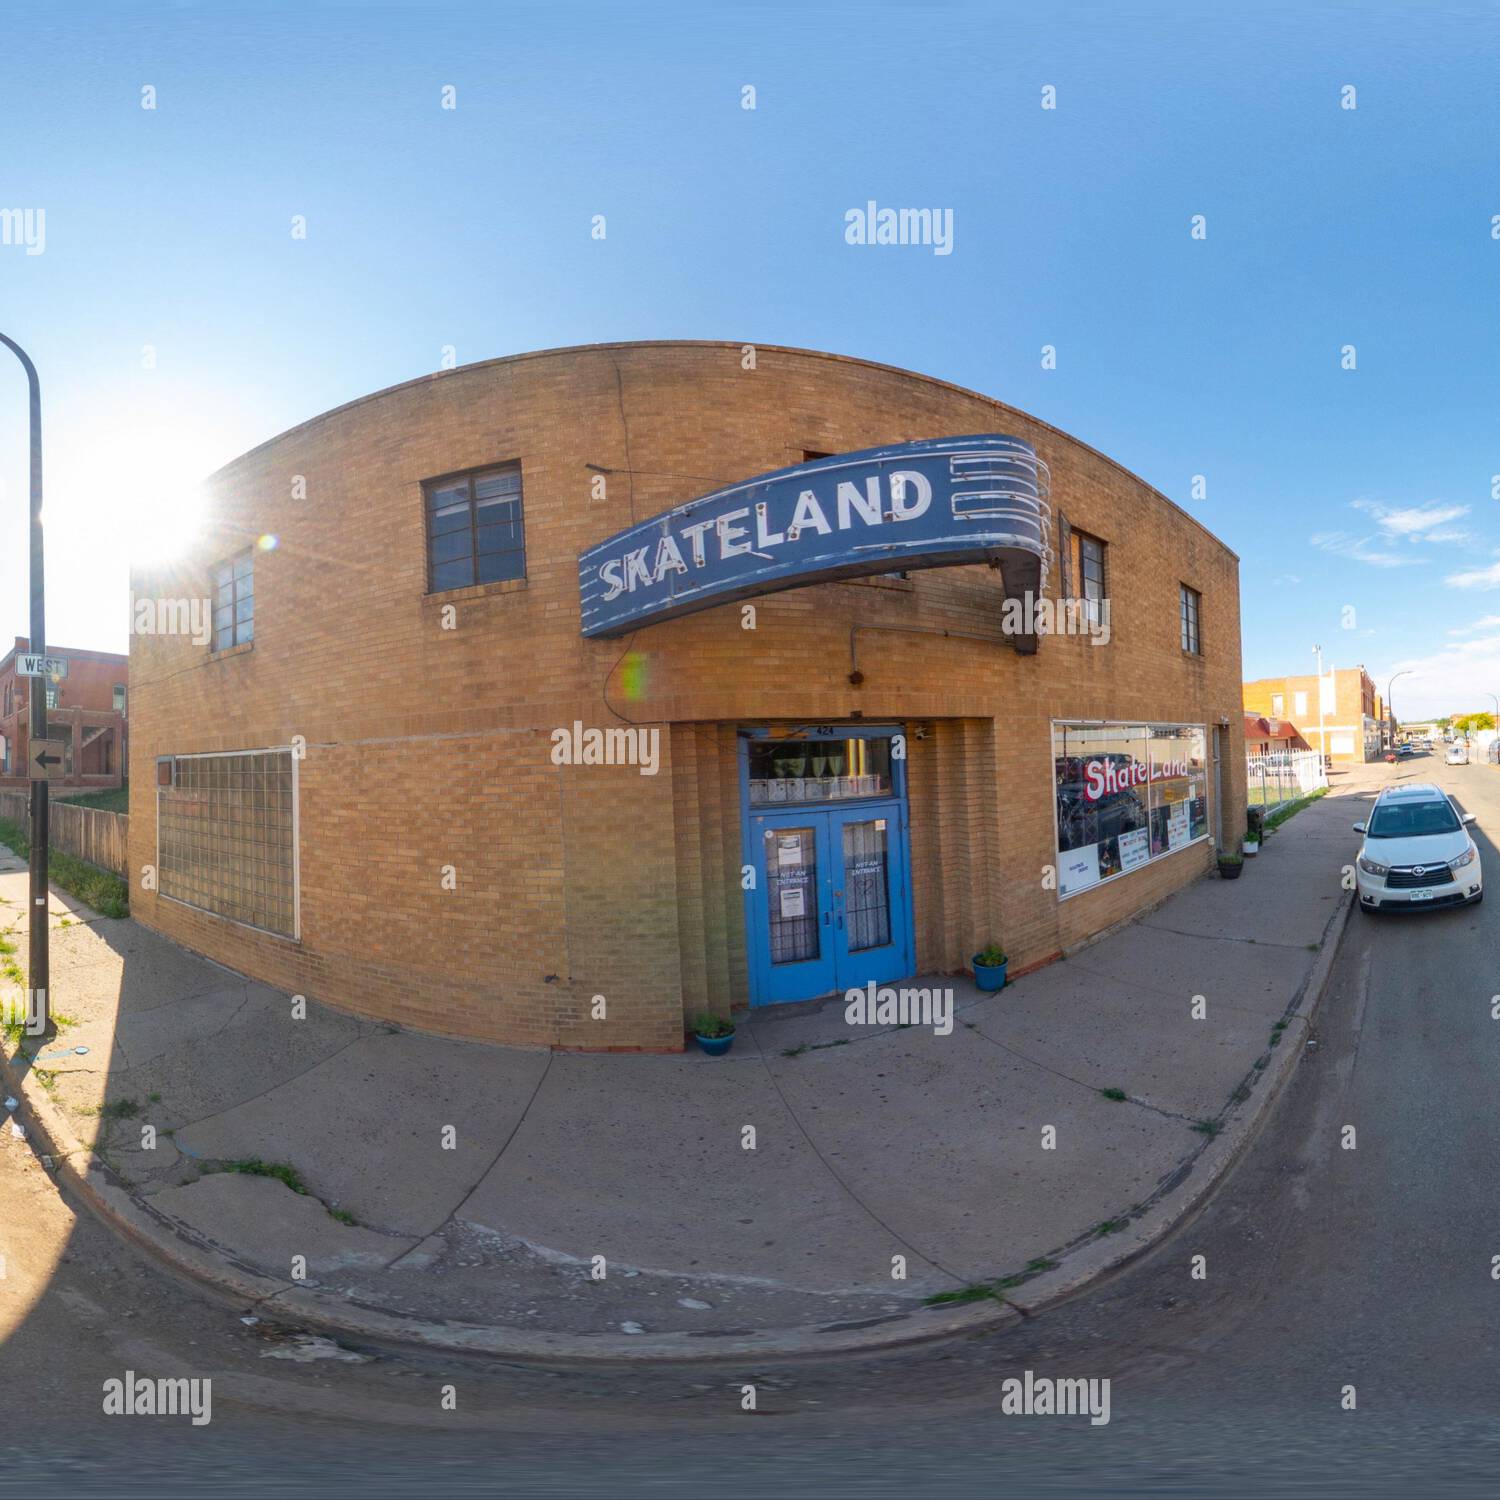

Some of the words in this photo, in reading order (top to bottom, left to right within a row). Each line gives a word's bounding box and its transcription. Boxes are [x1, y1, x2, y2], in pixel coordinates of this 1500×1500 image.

[598, 470, 933, 602] SKATELAND
[25, 657, 61, 673] WEST
[1085, 754, 1147, 802] Skate
